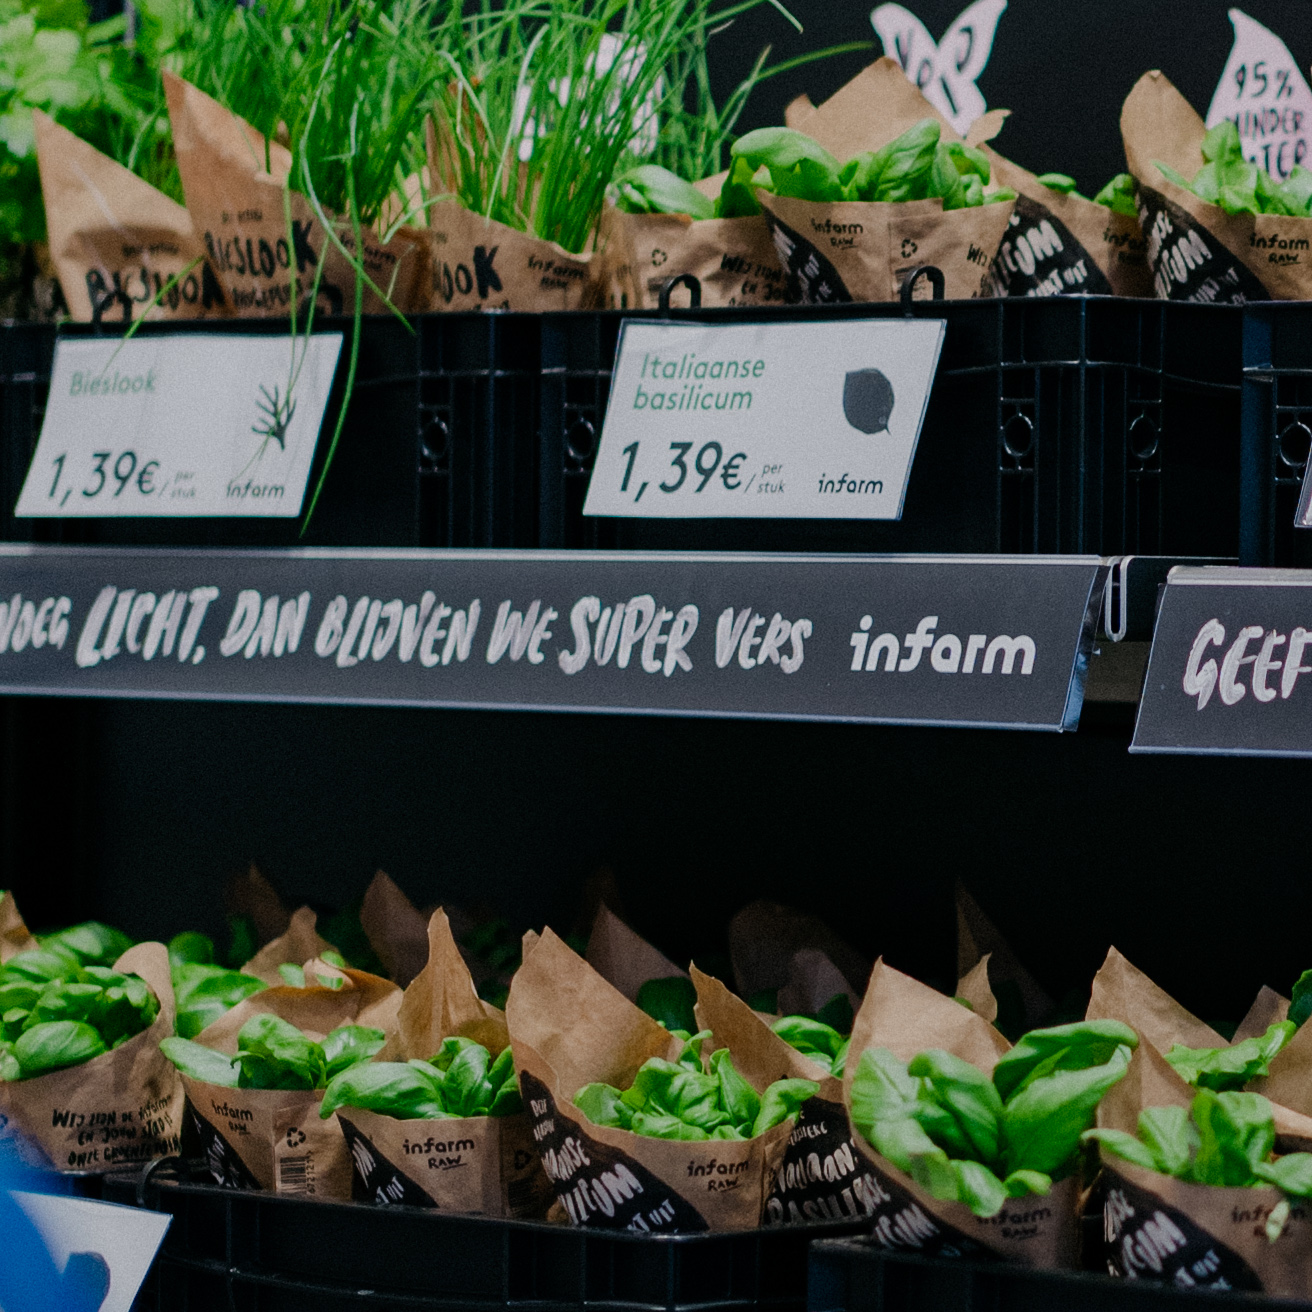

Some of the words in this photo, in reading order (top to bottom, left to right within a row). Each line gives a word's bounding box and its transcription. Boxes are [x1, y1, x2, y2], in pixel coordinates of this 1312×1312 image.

[640, 353, 766, 380] Italiaanse
[69, 369, 158, 397] Bieslook
[633, 385, 754, 411] basilicum
[761, 463, 784, 478] per
[757, 478, 787, 495] stuk
[817, 472, 884, 495] infarm
[75, 584, 220, 669] LICHT.
[219, 589, 311, 660] DAN
[314, 590, 482, 669] BLIJVEN
[485, 598, 559, 666] WE
[557, 593, 701, 678] SUPER
[715, 605, 813, 676] VERS
[849, 613, 1038, 676] infarm
[402, 1137, 475, 1156] infarm
[427, 1154, 468, 1170] RAW
[686, 1158, 750, 1179] infarm
